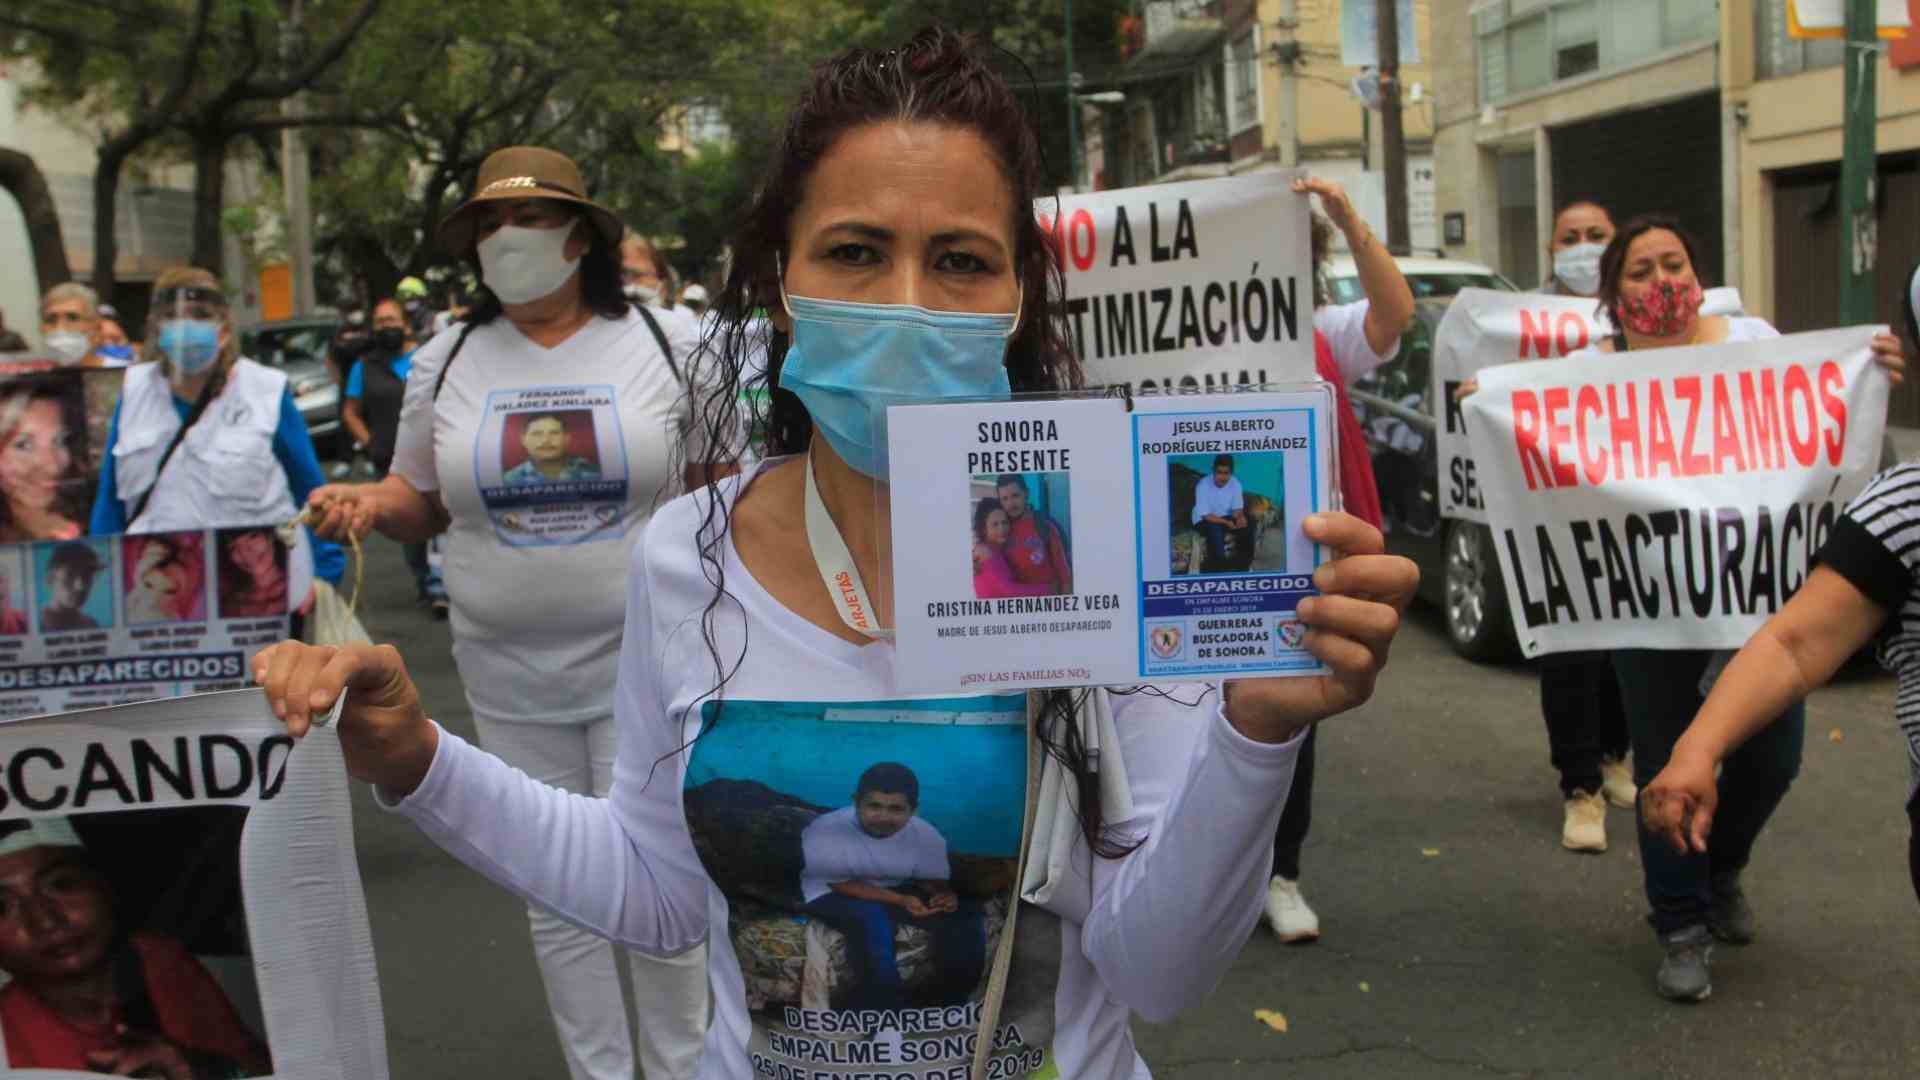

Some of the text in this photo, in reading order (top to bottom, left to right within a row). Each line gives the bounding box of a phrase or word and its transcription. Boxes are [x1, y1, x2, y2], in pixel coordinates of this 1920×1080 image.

[1110, 205, 1136, 267] A
[1148, 199, 1198, 262] LA
[1066, 261, 1298, 360] TIMIZACIÓN
[1519, 309, 1588, 359] NO
[978, 419, 1059, 444] SONORA
[1173, 418, 1275, 435] JESUS ALBERTO
[1511, 361, 1847, 491] RECHAZAMOS
[1142, 436, 1308, 455] RODRÍGUEZ HERNÁNDEZ
[968, 448, 1071, 474] PRESENTE
[1505, 476, 1849, 628] LA FACTURACIÓ
[835, 571, 870, 629] ARJETAS
[1147, 577, 1310, 595] DESAPARECIDO
[927, 594, 1120, 618] CRISTINA HERNÁNDEZ VEGA
[937, 626, 967, 638] MADRE
[969, 626, 980, 636] DE
[1010, 623, 1048, 635] ALBERTO
[1049, 620, 1112, 633] DESAPARECIDO
[1192, 631, 1270, 644] BUSCADORAS
[1198, 618, 1263, 630] GUERRERAS
[1198, 646, 1266, 658] DE SONORA
[0, 655, 240, 688] DESAPARECIDOS
[989, 672, 1009, 682] LAS
[1012, 669, 1065, 681] FAMILIAS
[0, 734, 294, 815] CANDO
[786, 1003, 985, 1033] DESAPARECI
[769, 1032, 892, 1064] EMPALME
[753, 1054, 776, 1077] 25
[988, 1049, 1043, 1080] 2019
